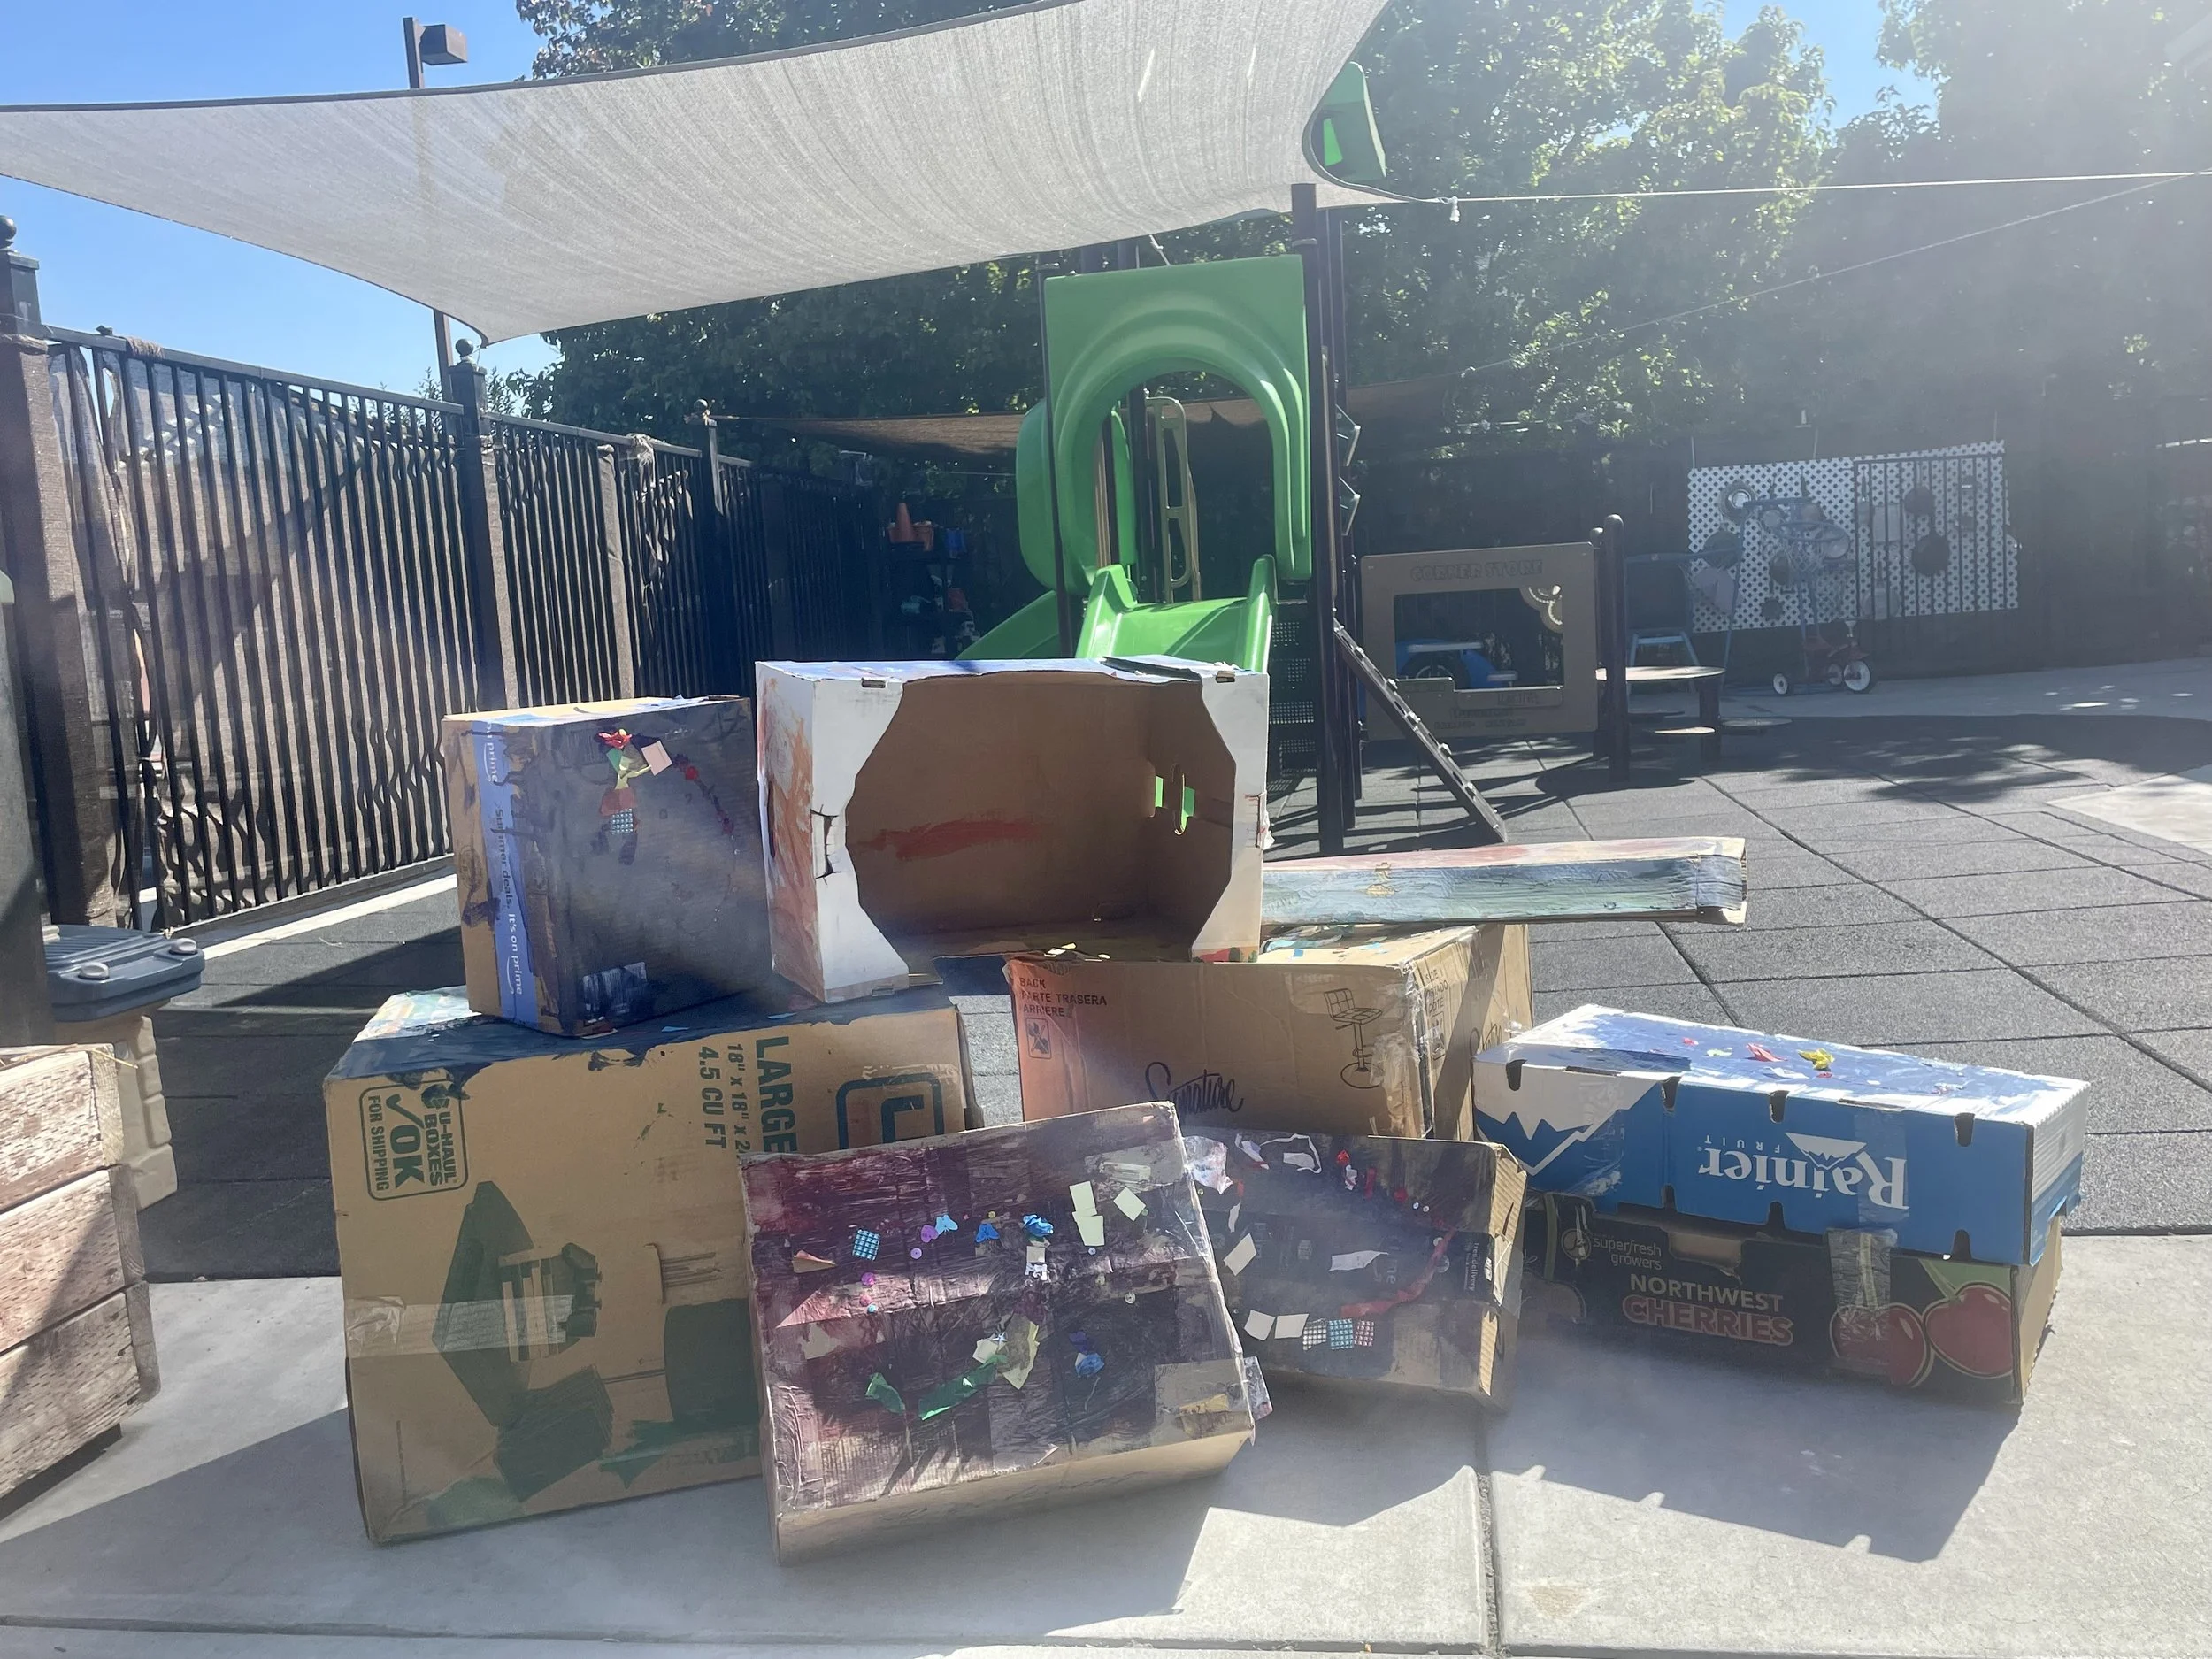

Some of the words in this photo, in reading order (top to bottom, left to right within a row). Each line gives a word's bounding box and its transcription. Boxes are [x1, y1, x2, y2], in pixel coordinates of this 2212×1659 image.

[511, 935, 518, 951] on
[511, 956, 523, 995] prime
[1019, 977, 1046, 989] BACK
[1021, 990, 1052, 1002] PARTE
[1056, 993, 1108, 1006] TRASERA
[699, 1046, 721, 1080] 4.5
[727, 1044, 745, 1071] 18"
[368, 1095, 383, 1122] FOR
[702, 1087, 724, 1115] CU
[731, 1092, 749, 1119] 18"
[756, 1036, 798, 1152] LARGE
[424, 1113, 442, 1186] BOXES
[439, 1111, 457, 1183] U-HAUL
[704, 1123, 726, 1149] FT
[1704, 1134, 1781, 1154] FRUIT
[371, 1126, 389, 1191] SHIPPING
[390, 1125, 426, 1188] OK
[1698, 1148, 1909, 1210] Rainier
[1593, 1237, 1663, 1257] superfresh
[1610, 1253, 1663, 1271] growers
[1468, 1259, 1479, 1292] delivery
[1630, 1273, 1784, 1312] NORTHWEST
[1623, 1294, 1793, 1346] CHERRIES
